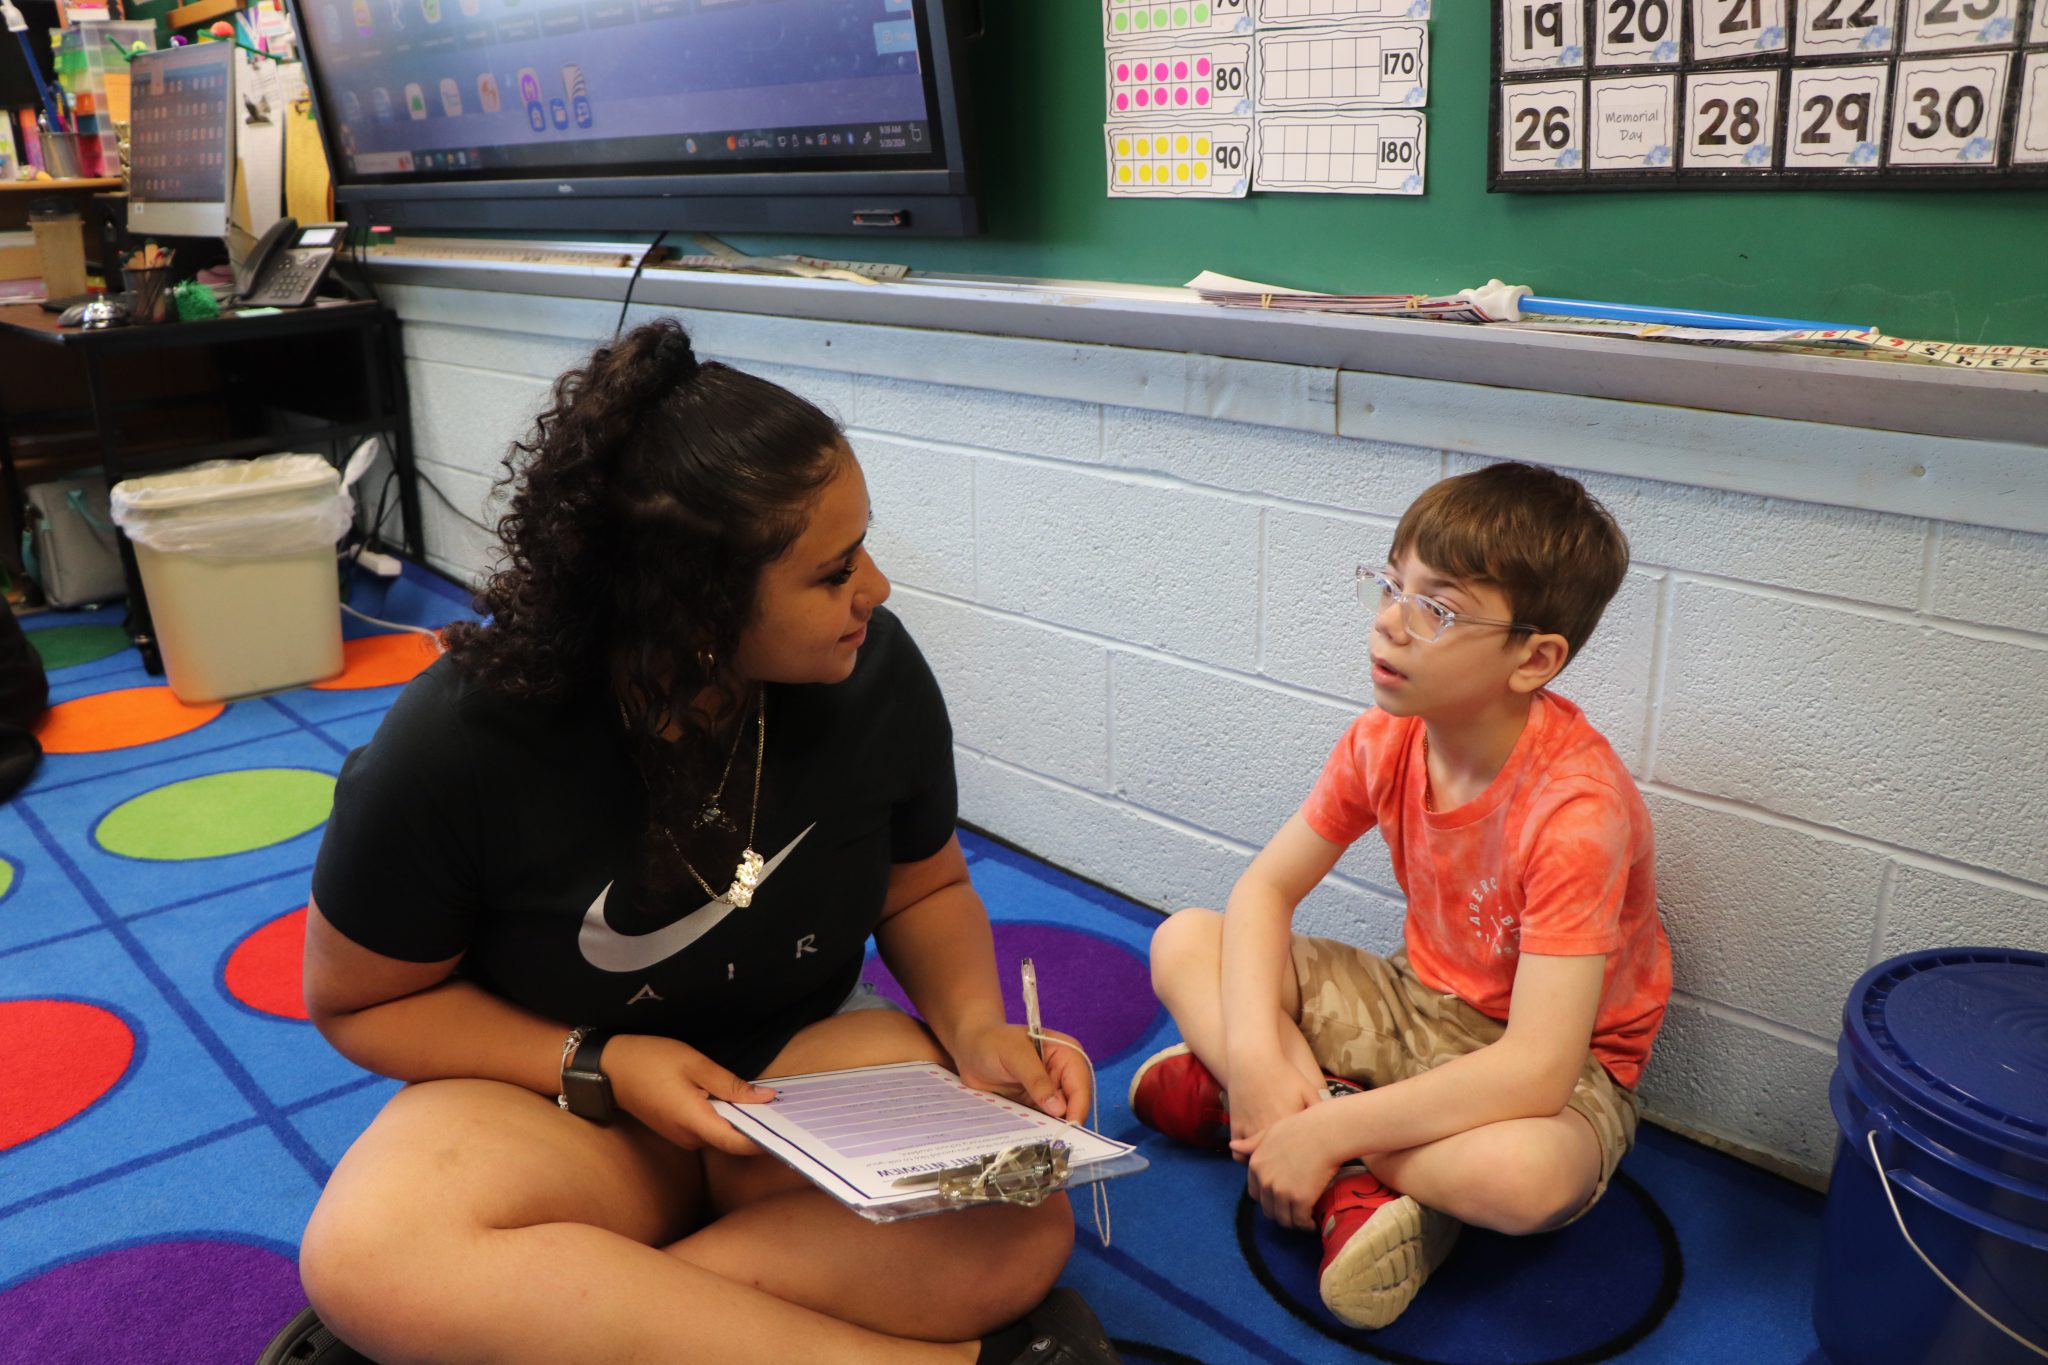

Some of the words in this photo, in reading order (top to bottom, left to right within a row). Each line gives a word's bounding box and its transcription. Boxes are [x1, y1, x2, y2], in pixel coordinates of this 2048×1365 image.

[1523, 1, 1563, 50] 19
[1607, 0, 1669, 44] 20
[1718, 0, 1762, 34] 21
[1215, 67, 1242, 91] 80
[1383, 52, 1415, 75] 170
[1514, 105, 1571, 151] 26
[1605, 109, 1660, 124] Memorial
[1697, 97, 1760, 146] 28
[1800, 92, 1871, 144] 29
[1906, 85, 1985, 140] 30
[1380, 141, 1413, 163] 180
[1620, 129, 1643, 143] Day
[1215, 146, 1242, 169] 90
[625, 932, 819, 1006] AIR
[876, 1161, 949, 1178] INTERVIEW
